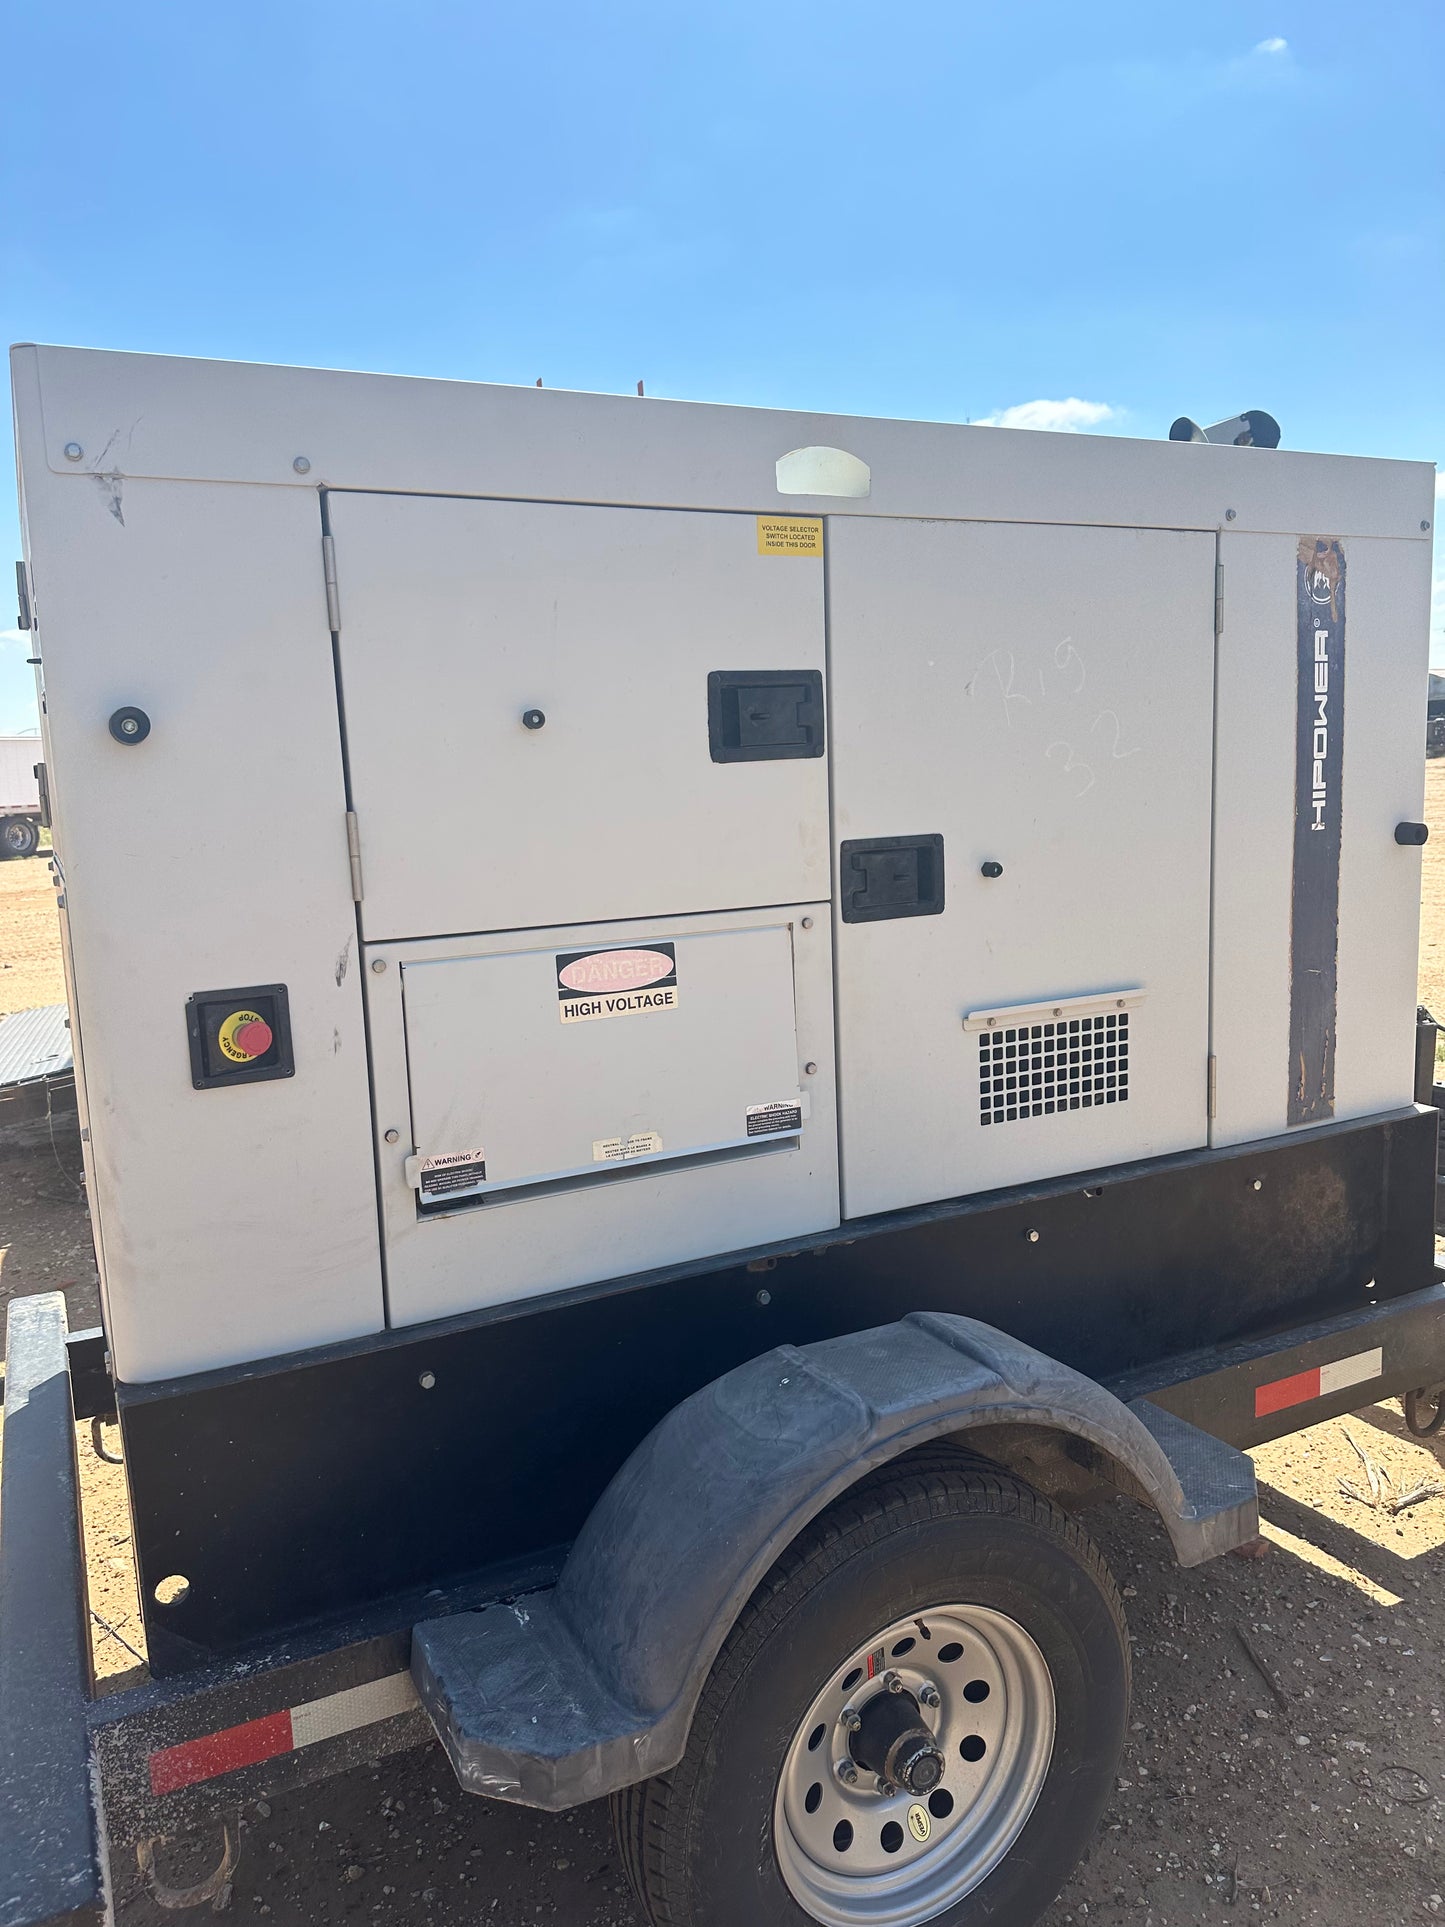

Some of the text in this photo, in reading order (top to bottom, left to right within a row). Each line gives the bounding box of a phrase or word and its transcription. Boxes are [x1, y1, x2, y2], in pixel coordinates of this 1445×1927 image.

[1312, 630, 1329, 831] HIPOWER
[571, 957, 664, 985] DANGER
[564, 992, 674, 1018] HIGH VOLTAGE
[435, 1154, 471, 1165] WARNING
